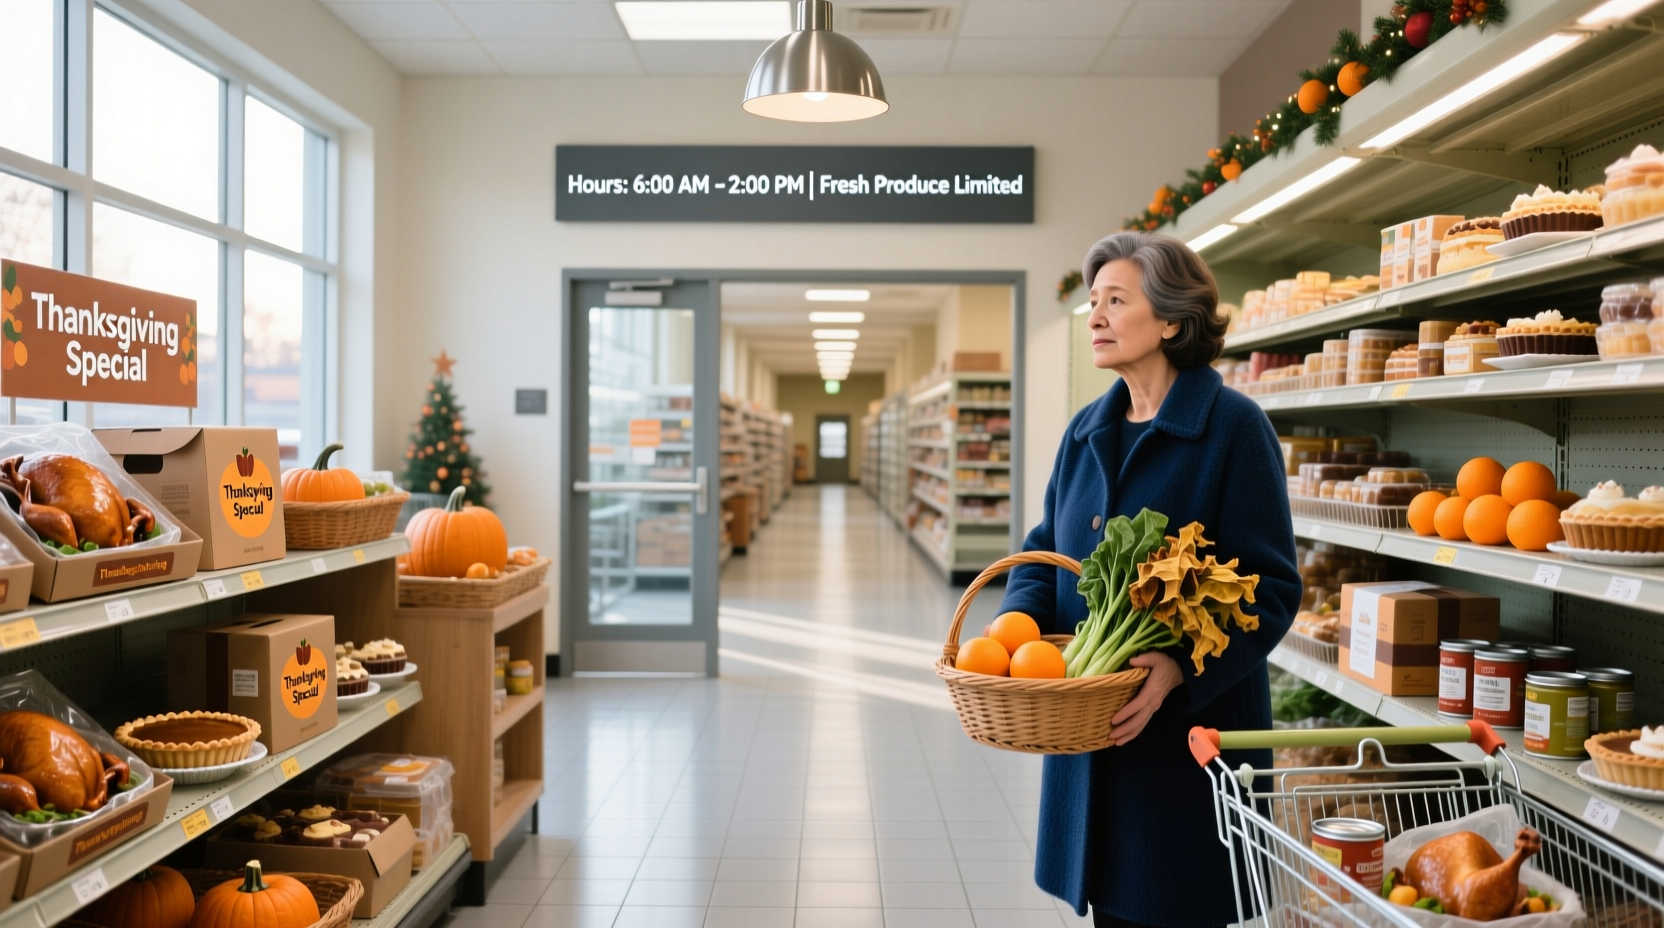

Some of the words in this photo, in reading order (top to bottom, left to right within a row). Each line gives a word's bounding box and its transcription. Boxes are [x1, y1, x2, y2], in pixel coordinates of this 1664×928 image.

[567, 173, 629, 195] Hours:
[632, 173, 675, 195] 6:00
[677, 174, 710, 195] AM
[727, 174, 771, 195] 2:00
[774, 174, 805, 195] PM
[819, 173, 870, 195] Fresh
[874, 173, 951, 195] Produce
[954, 173, 1023, 195] Limited
[30, 291, 179, 357] Thanksgiving
[66, 339, 147, 387] Special
